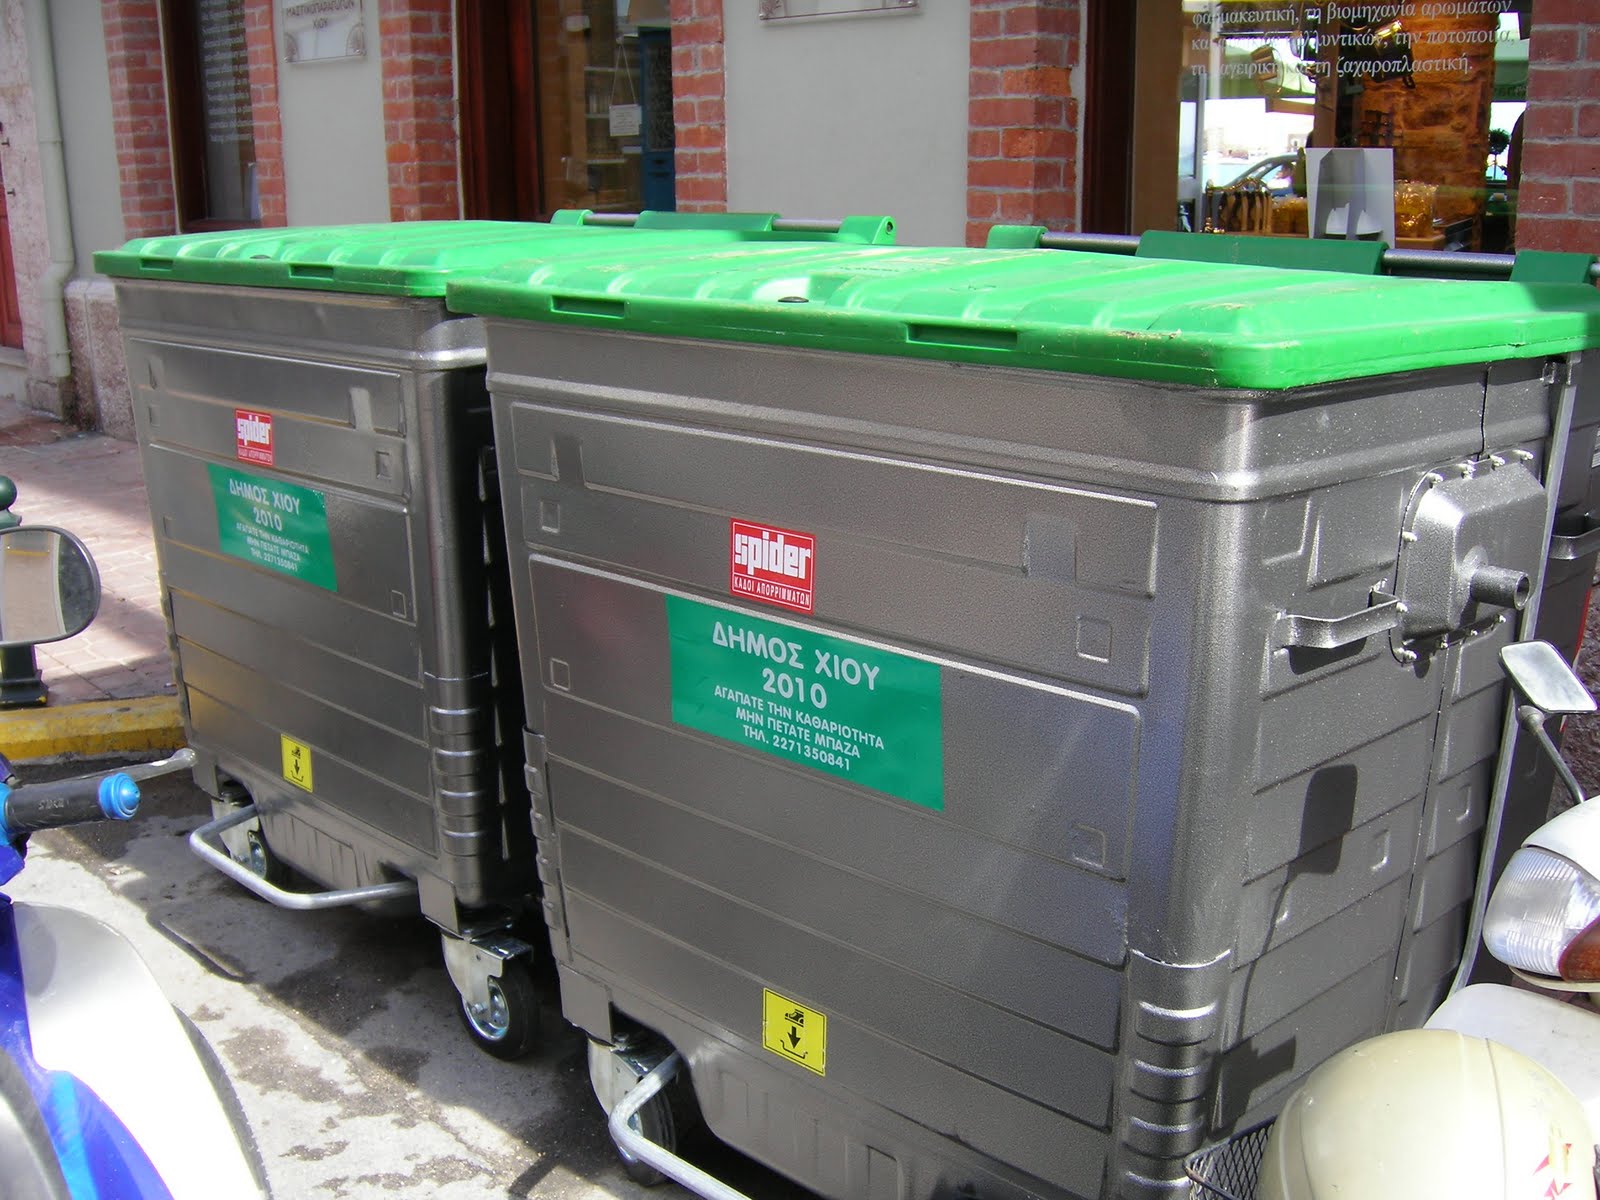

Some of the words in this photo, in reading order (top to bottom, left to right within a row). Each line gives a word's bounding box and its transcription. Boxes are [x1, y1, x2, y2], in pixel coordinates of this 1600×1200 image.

[1304, 7, 1321, 24] τη
[1327, 1, 1416, 24] βιομηχανία
[1394, 30, 1423, 49] την
[1315, 61, 1331, 77] τη
[1336, 54, 1473, 78] ζαχαροπλαστική.
[237, 414, 271, 446] spider
[229, 478, 270, 506] ΔΗΜΟΣ
[272, 490, 300, 515] ΧΙΟΥ
[253, 507, 282, 532] 2010
[734, 530, 811, 580] spider
[734, 576, 755, 592] ΚΑΔΟΙ
[756, 582, 810, 606] ΑΠΟΡΡΙΜΜΑΤΩΝ
[712, 621, 804, 669] ΔΗΜΟΣ
[814, 649, 880, 691] ΧΙΟΥ
[762, 668, 828, 710] 2010
[713, 684, 764, 711] ΑΓΑΠΑΤΕ
[766, 700, 792, 720] ΤΗΝ
[795, 709, 885, 750] ΚΑΘΑΡΙΟΤΗΤΑ
[735, 706, 764, 727] ΜΗΝ
[767, 717, 810, 743] ΠΕΤΑΤΕ
[814, 732, 861, 759] ΜΠΑΖΑ
[743, 724, 770, 744] ΤΗΛ.
[772, 734, 851, 771] 2271350841
